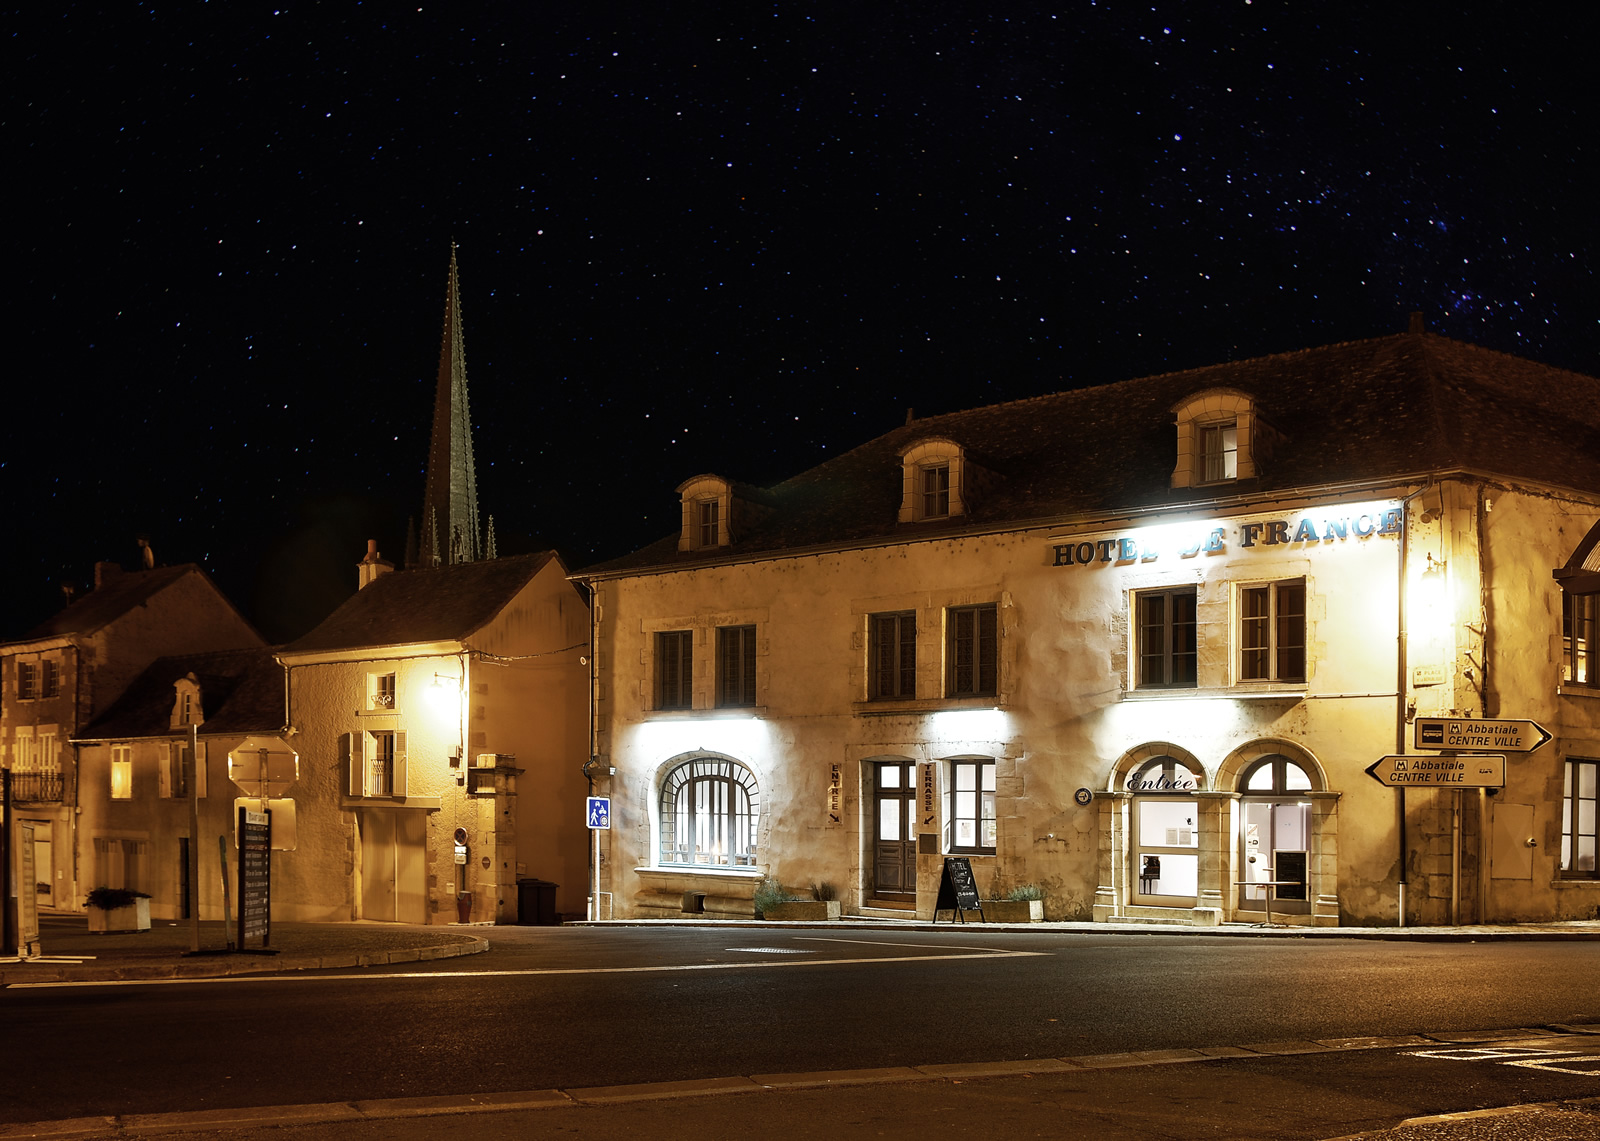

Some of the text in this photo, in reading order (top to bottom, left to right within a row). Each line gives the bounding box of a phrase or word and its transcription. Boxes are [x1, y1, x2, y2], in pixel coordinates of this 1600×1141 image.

[1177, 527, 1224, 556] E
[1241, 507, 1402, 548] FRANCE
[1465, 724, 1518, 735] Abbatiale
[1448, 736, 1522, 747] CENTRE VILLE
[1412, 760, 1465, 771] Abbatiale
[1126, 771, 1193, 790] Entrée
[1389, 772, 1465, 782] CENTRE VILLE
[831, 764, 839, 811] ENTREE
[924, 764, 932, 812] TERRASSE
